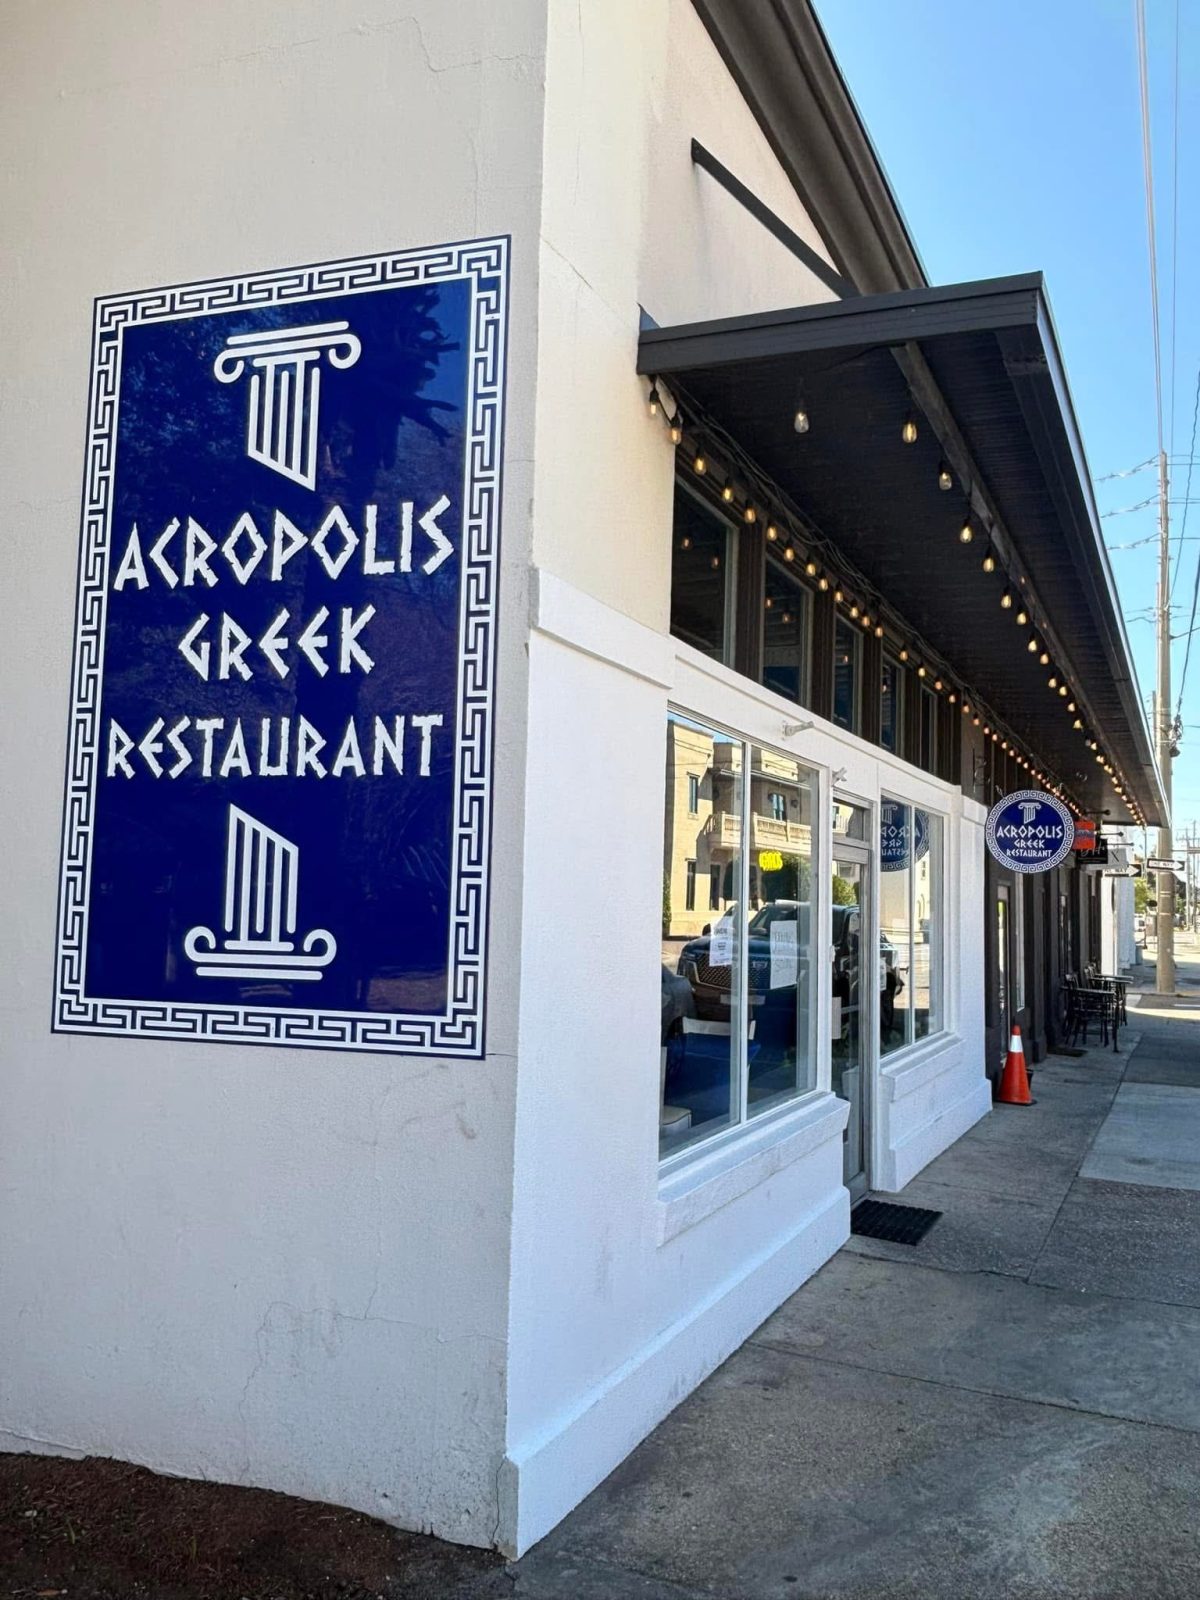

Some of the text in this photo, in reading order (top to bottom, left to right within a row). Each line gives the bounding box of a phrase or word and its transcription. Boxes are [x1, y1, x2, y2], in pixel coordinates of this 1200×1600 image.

[114, 494, 454, 591] ACROPOLIS
[178, 604, 376, 681] GREEK
[106, 714, 444, 779] RESTAURANT
[996, 825, 1063, 839] ACROPOLIS
[1013, 839, 1045, 848] GREEK
[1006, 848, 1053, 858] RESTAURANT
